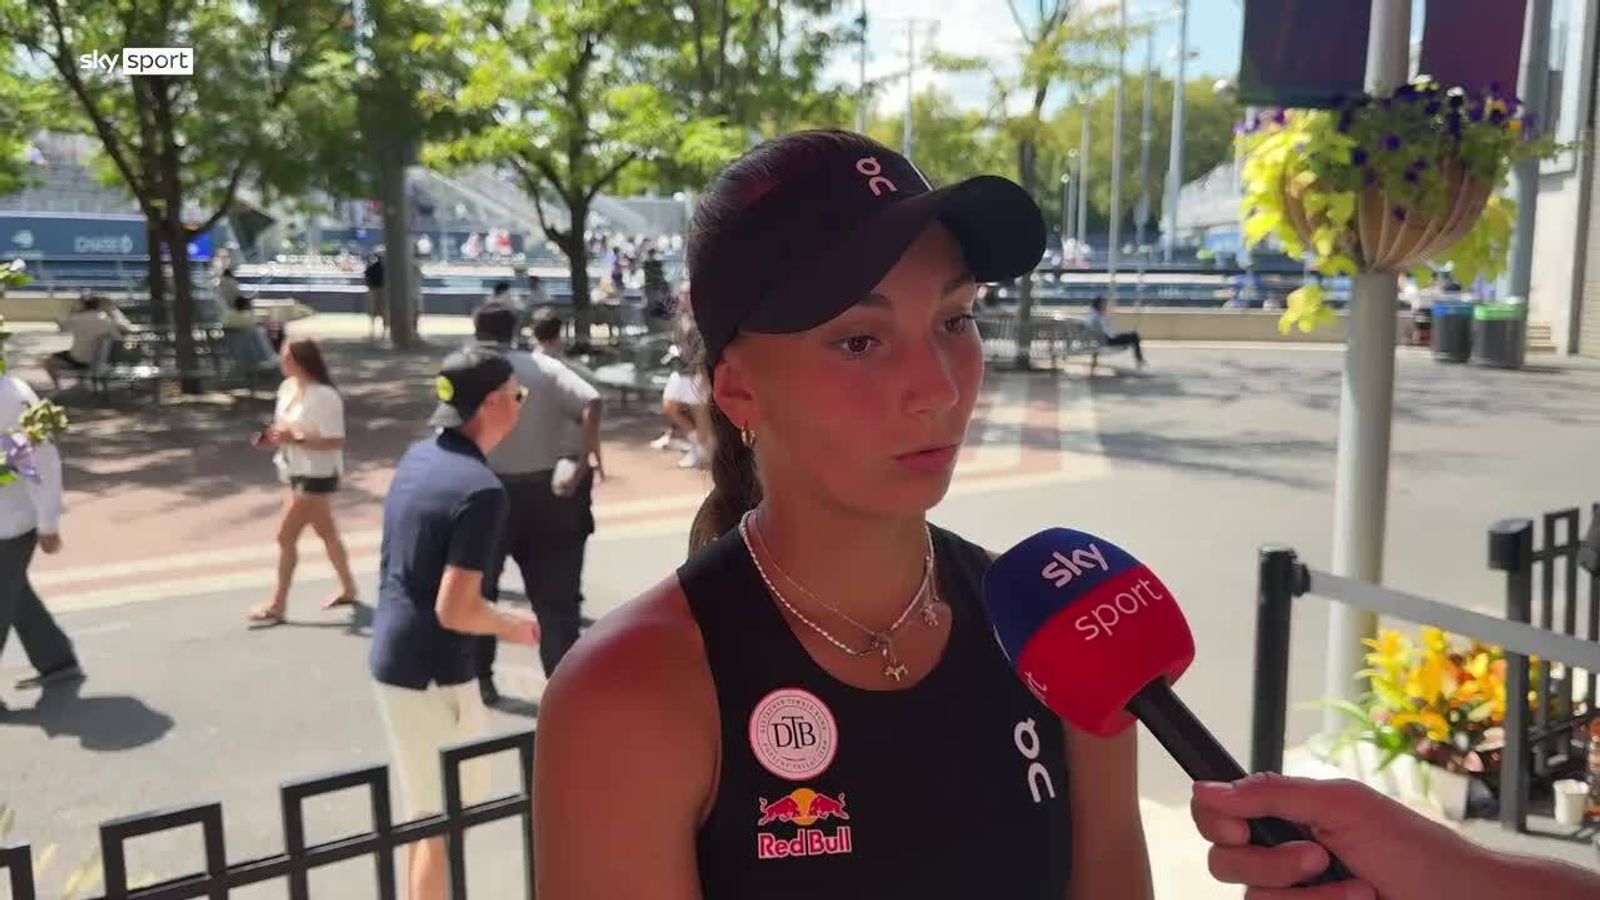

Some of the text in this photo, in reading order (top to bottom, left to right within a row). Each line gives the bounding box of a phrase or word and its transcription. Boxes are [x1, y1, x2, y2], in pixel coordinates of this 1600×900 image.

[1041, 543, 1110, 588] sky
[1074, 577, 1164, 641] sport
[771, 715, 817, 749] DTB
[758, 826, 852, 859] Red Bull
